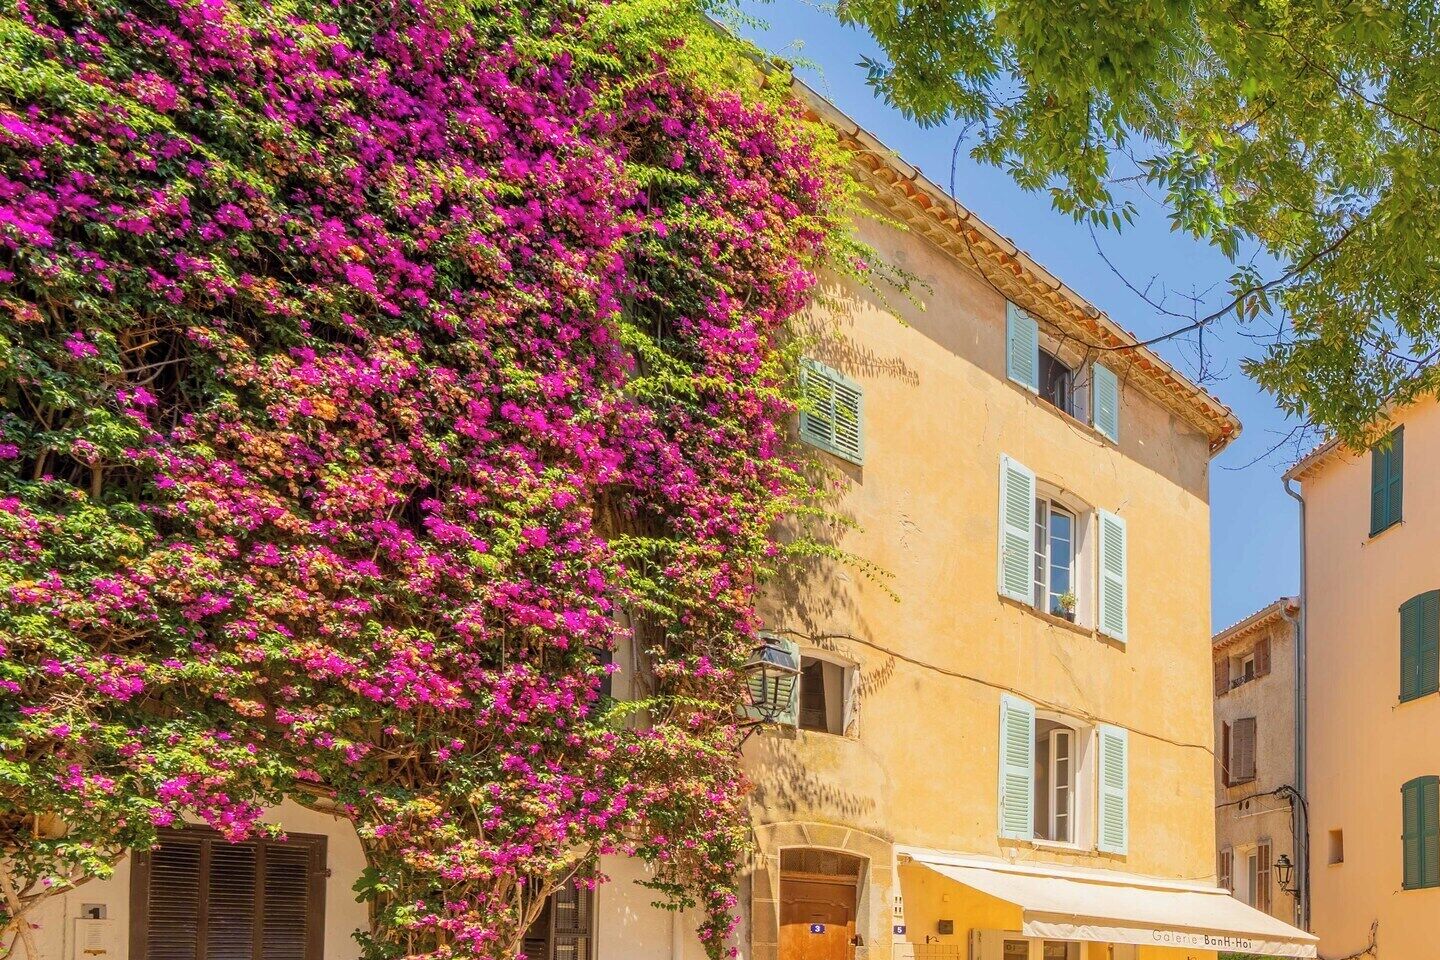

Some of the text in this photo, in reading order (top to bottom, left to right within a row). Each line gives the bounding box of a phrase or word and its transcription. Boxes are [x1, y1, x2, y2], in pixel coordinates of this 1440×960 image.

[88, 907, 100, 919] 1
[814, 925, 821, 933] 3
[897, 926, 903, 934] 5
[1152, 929, 1198, 945] Galerie
